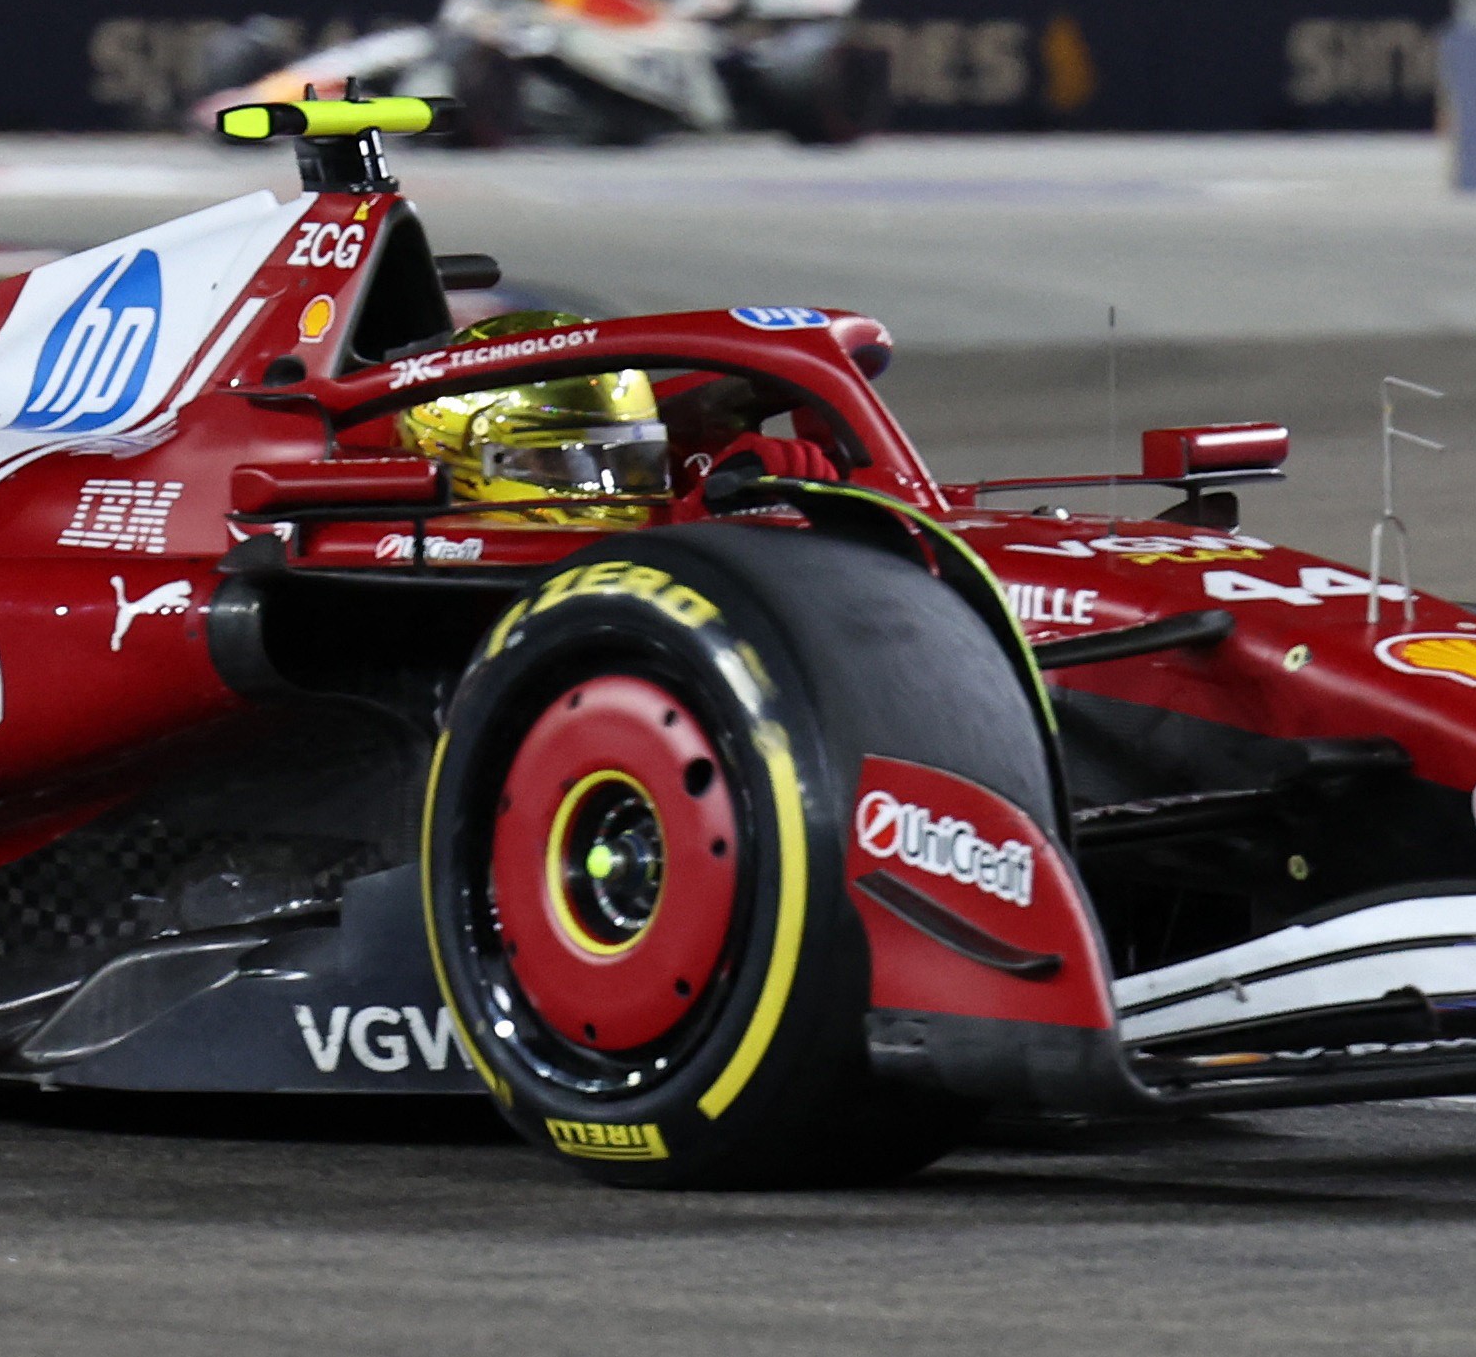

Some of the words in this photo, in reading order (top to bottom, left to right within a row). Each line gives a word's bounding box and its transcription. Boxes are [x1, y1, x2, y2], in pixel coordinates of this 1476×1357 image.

[286, 221, 365, 269] ZCG
[27, 252, 155, 431] hp
[449, 327, 599, 368] TECHNOLOGY
[56, 479, 184, 554] IBM
[529, 561, 722, 628] ZERO
[1202, 566, 1419, 606] 44
[900, 803, 1034, 908] UniCredit
[292, 1004, 476, 1073] VGW
[545, 1118, 670, 1163] PIRELLI
